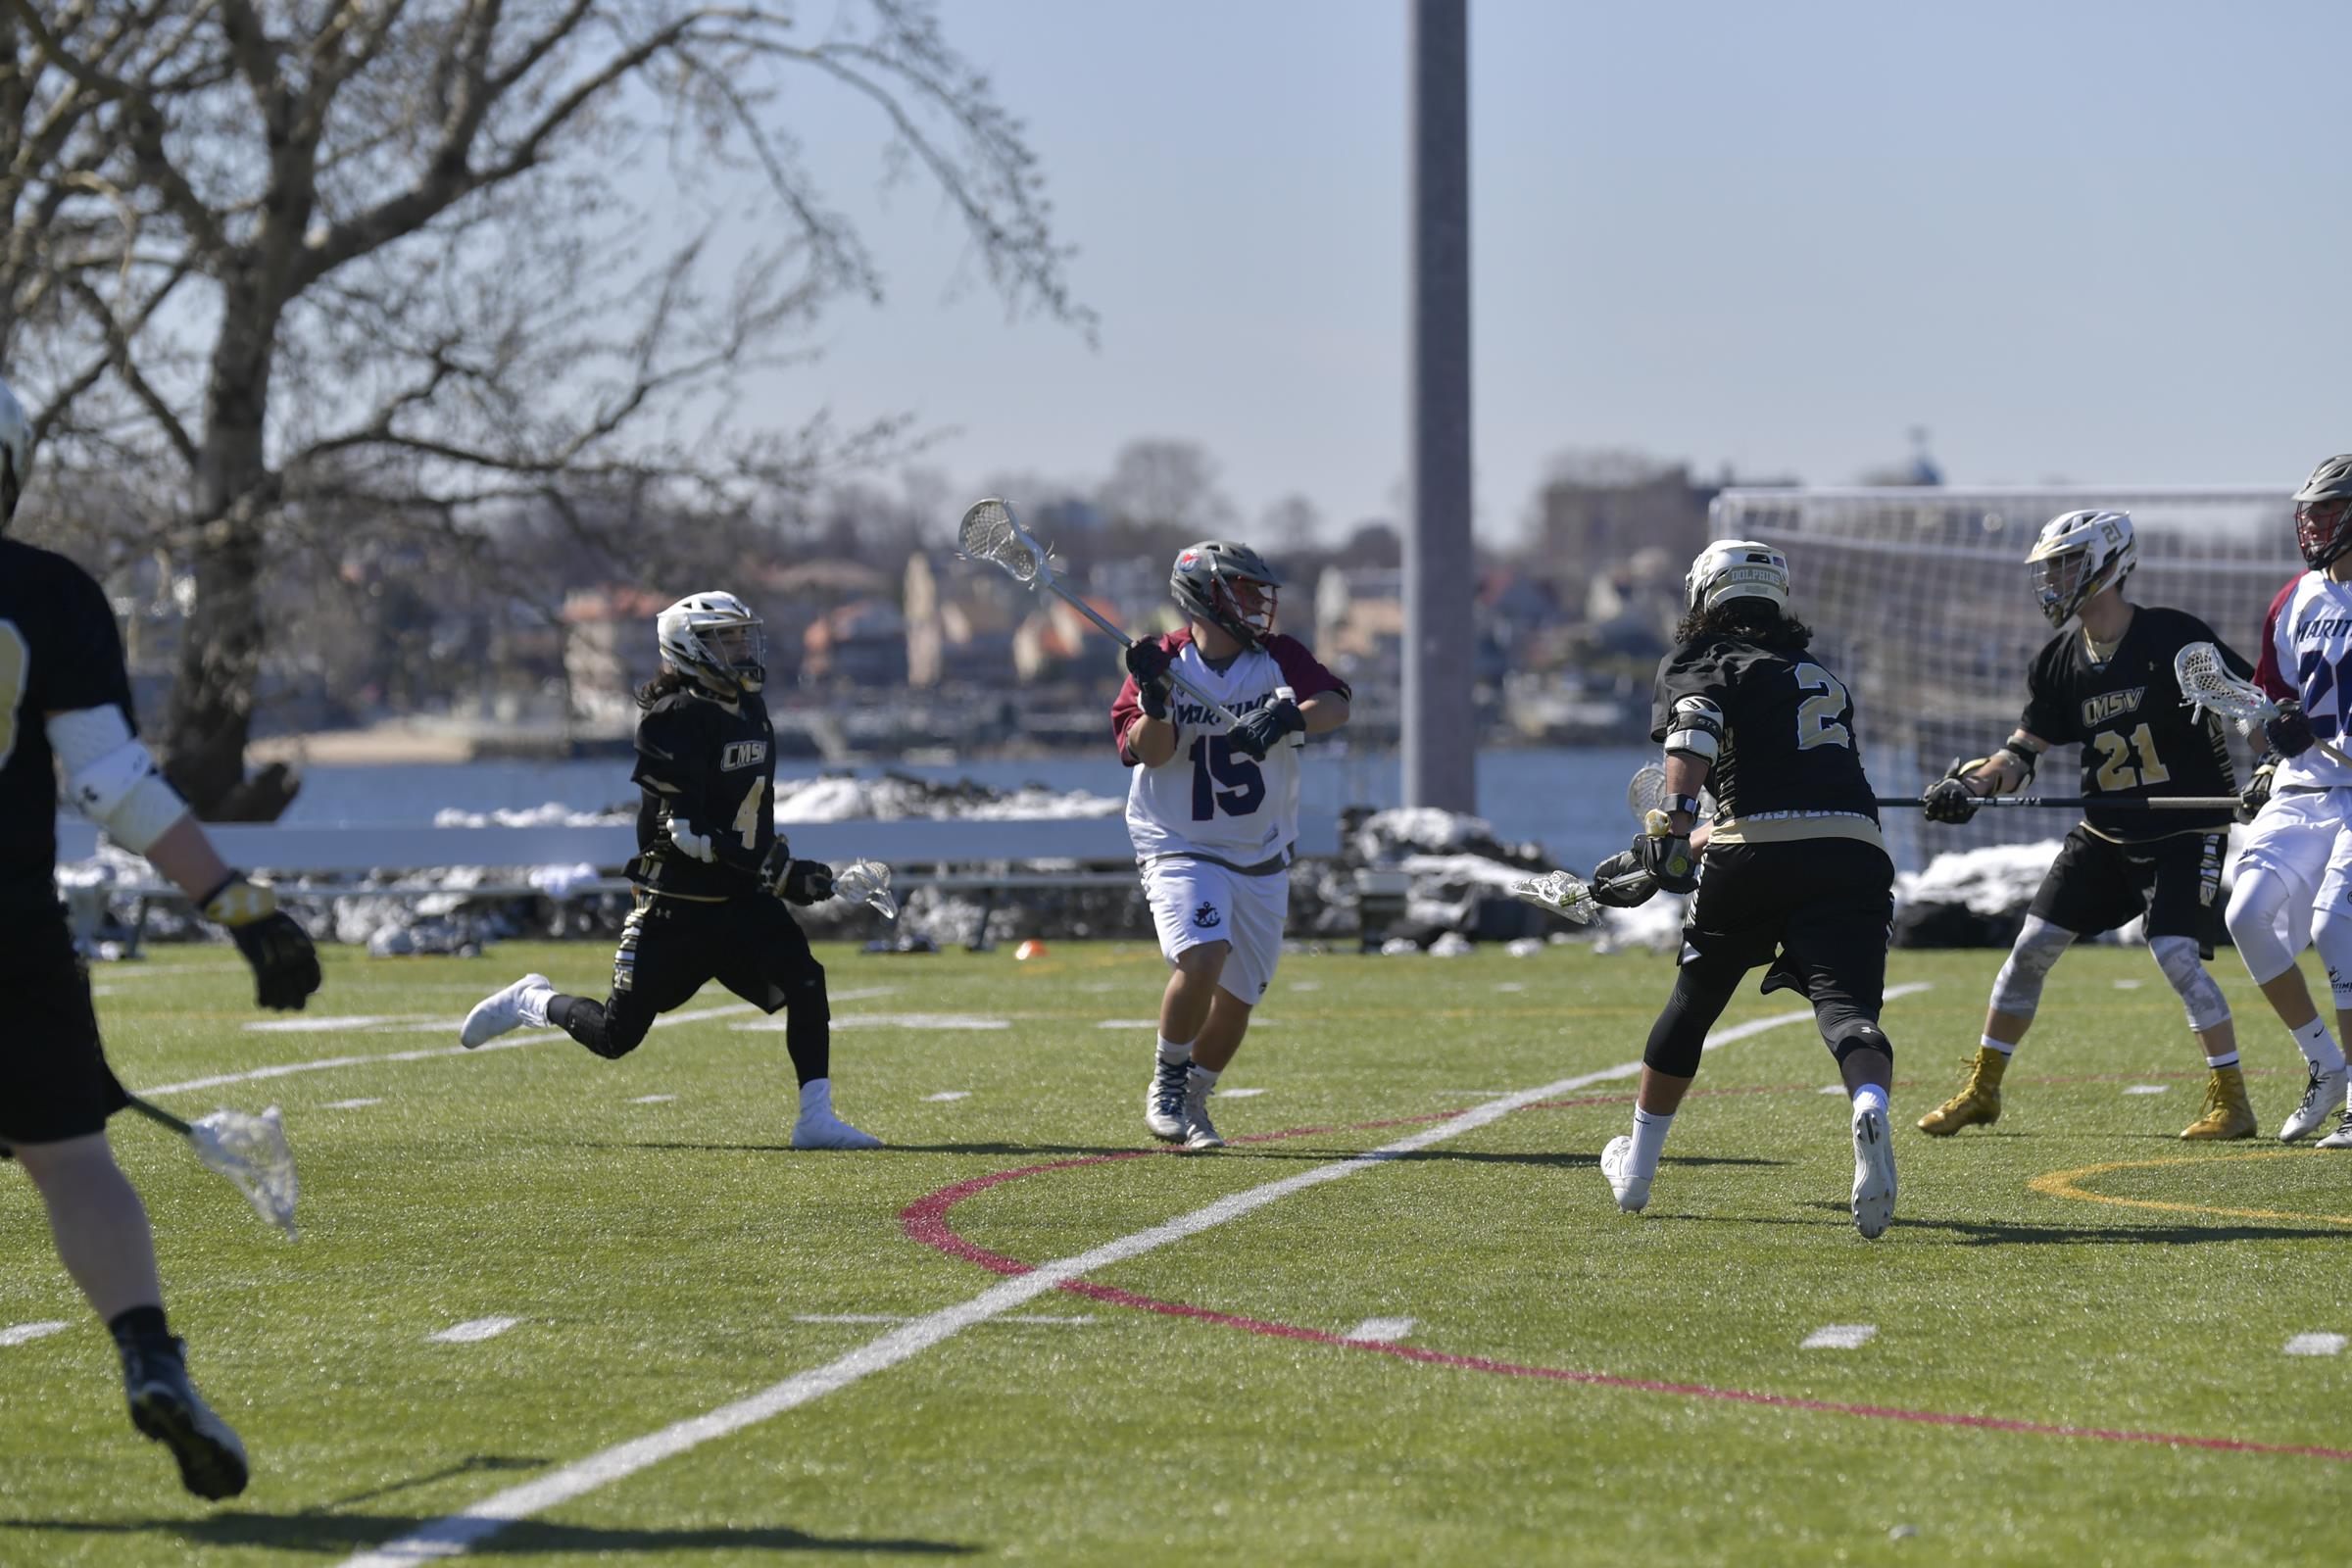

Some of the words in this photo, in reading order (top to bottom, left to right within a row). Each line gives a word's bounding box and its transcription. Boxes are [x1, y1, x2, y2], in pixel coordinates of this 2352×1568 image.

[2101, 521, 2124, 545] 21
[1701, 554, 1713, 577] 2
[1731, 569, 1782, 585] DOLPHINS
[2295, 618, 2352, 644] MARIT
[1794, 662, 1849, 750] 2
[1189, 735, 1266, 821] 15
[2093, 722, 2171, 792] 21
[731, 775, 765, 851] 4
